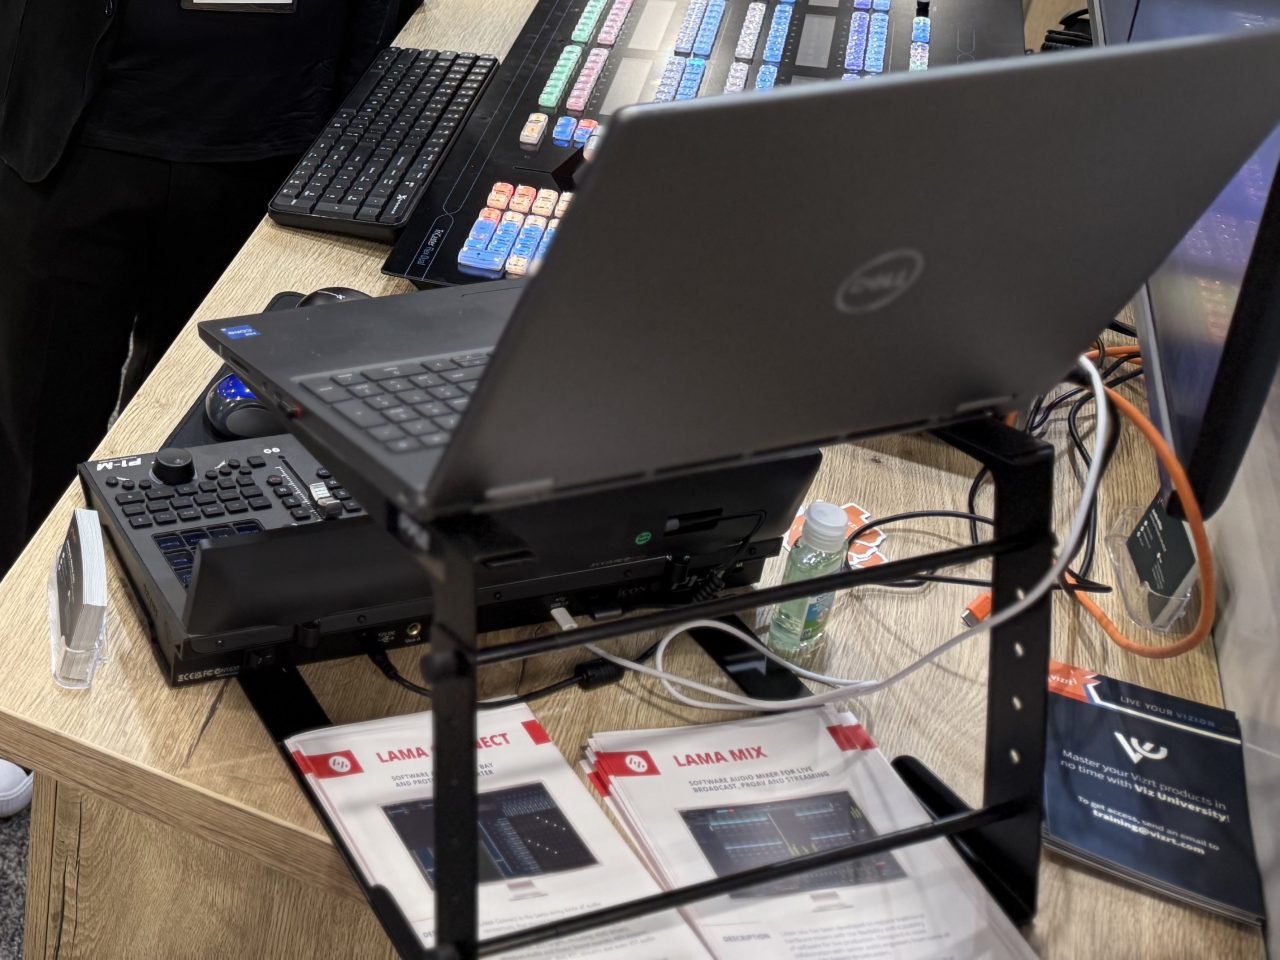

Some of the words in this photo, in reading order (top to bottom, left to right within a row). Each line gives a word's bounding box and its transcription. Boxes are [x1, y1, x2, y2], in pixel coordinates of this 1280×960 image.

[96, 457, 142, 471] P1-M
[1120, 695, 1141, 708] LIVE
[1145, 702, 1173, 717] YOUR
[376, 746, 430, 764] LAMA
[673, 751, 730, 768] LAMA
[729, 745, 768, 761] MIX
[391, 772, 429, 782] SOFTWARE
[395, 780, 412, 788] AND
[688, 777, 729, 787] SOFTWARE
[730, 774, 754, 784] AUDIO
[755, 771, 780, 781] MIXER
[780, 769, 797, 778] FOR
[797, 766, 814, 775] LIVE
[767, 777, 785, 786] AND
[785, 770, 830, 783] STREAMING
[1062, 749, 1100, 768] Master
[1102, 764, 1129, 778] your
[1131, 772, 1157, 788] Vizrt
[1159, 784, 1213, 806] products
[1214, 800, 1227, 811] in
[1060, 760, 1076, 770] no
[1078, 764, 1105, 780] time
[1106, 775, 1133, 790] with
[1133, 783, 1156, 798] Viz
[1157, 791, 1230, 823] University!
[1090, 801, 1106, 812] get
[1107, 807, 1140, 824] access,
[1141, 819, 1165, 832] send
[1166, 828, 1179, 837] an
[1180, 833, 1207, 847] email
[1208, 841, 1220, 851] to
[1092, 809, 1206, 855] training@vizrt.com
